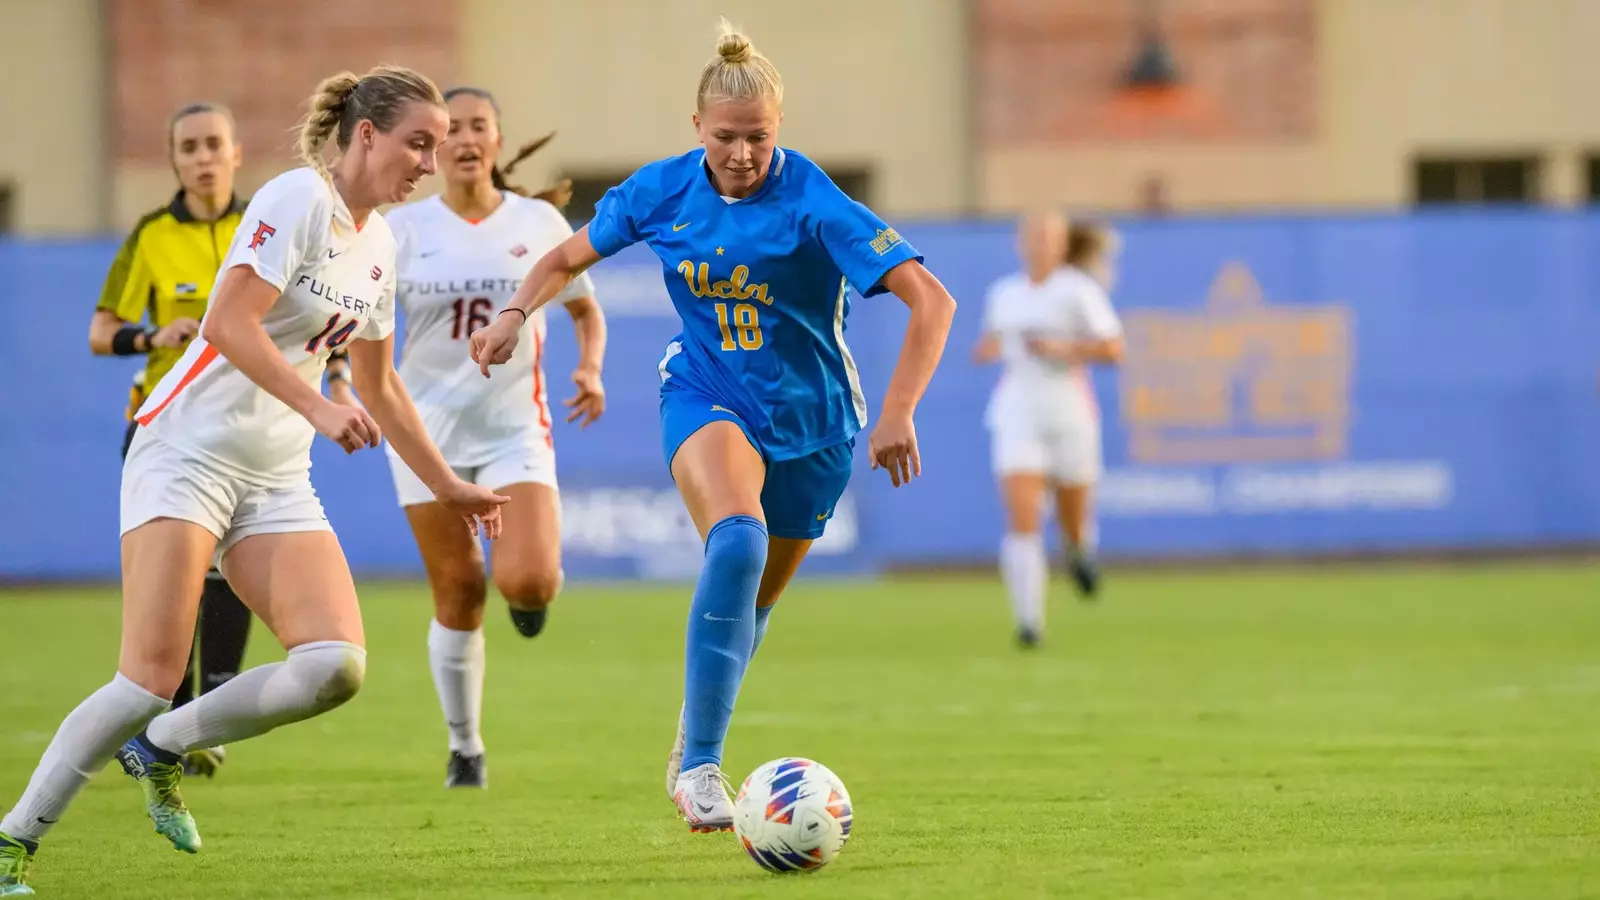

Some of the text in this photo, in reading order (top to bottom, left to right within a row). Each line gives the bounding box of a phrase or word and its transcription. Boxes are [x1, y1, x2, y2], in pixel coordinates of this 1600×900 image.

[248, 220, 276, 252] F
[296, 274, 372, 317] FULLERT
[450, 295, 494, 341] 16
[715, 303, 764, 351] 18
